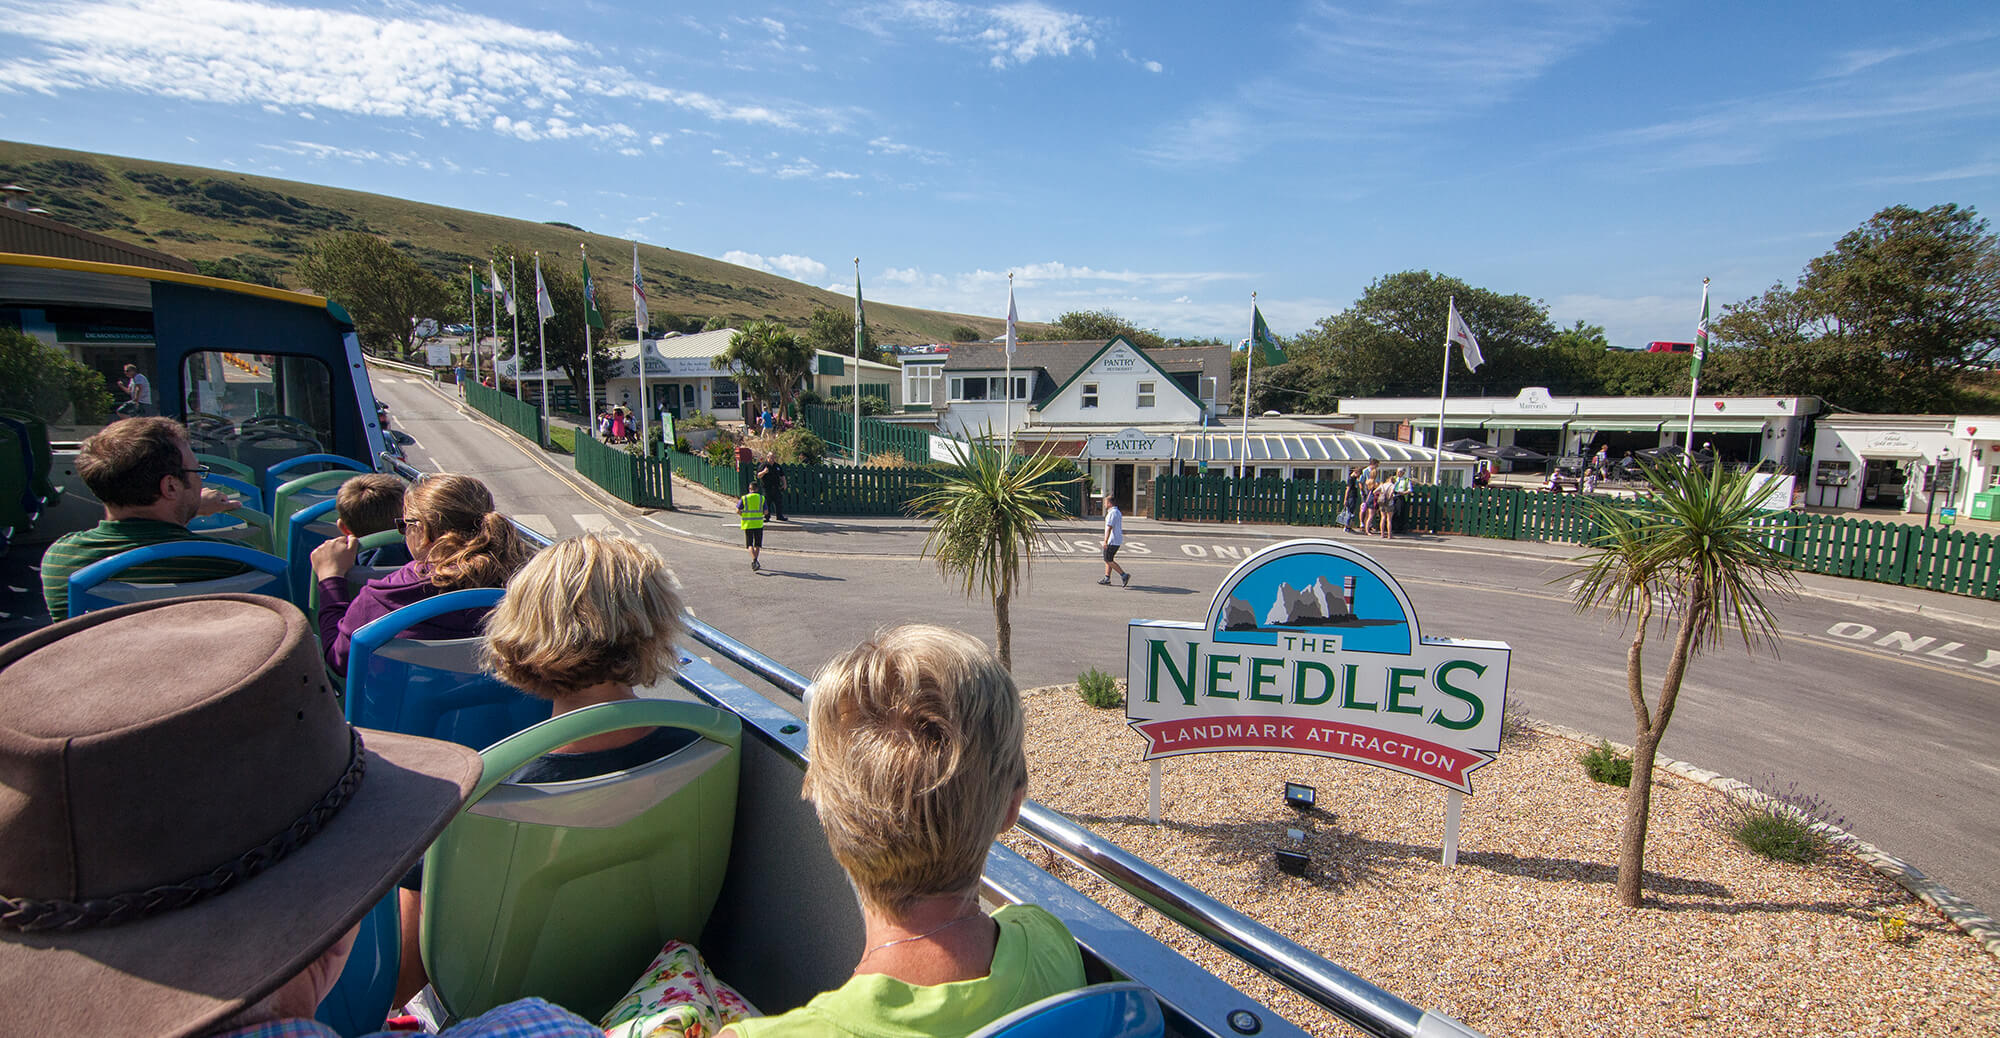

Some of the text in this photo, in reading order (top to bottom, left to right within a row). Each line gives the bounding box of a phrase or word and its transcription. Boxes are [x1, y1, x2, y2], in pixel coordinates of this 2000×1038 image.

[1104, 358, 1136, 366] PANTRY
[1106, 439, 1156, 450] PANTRY
[1284, 636, 1337, 654] THE
[1142, 638, 1489, 731] NEEDLES
[1161, 719, 1456, 773] LANDMARK ATTRACTION
